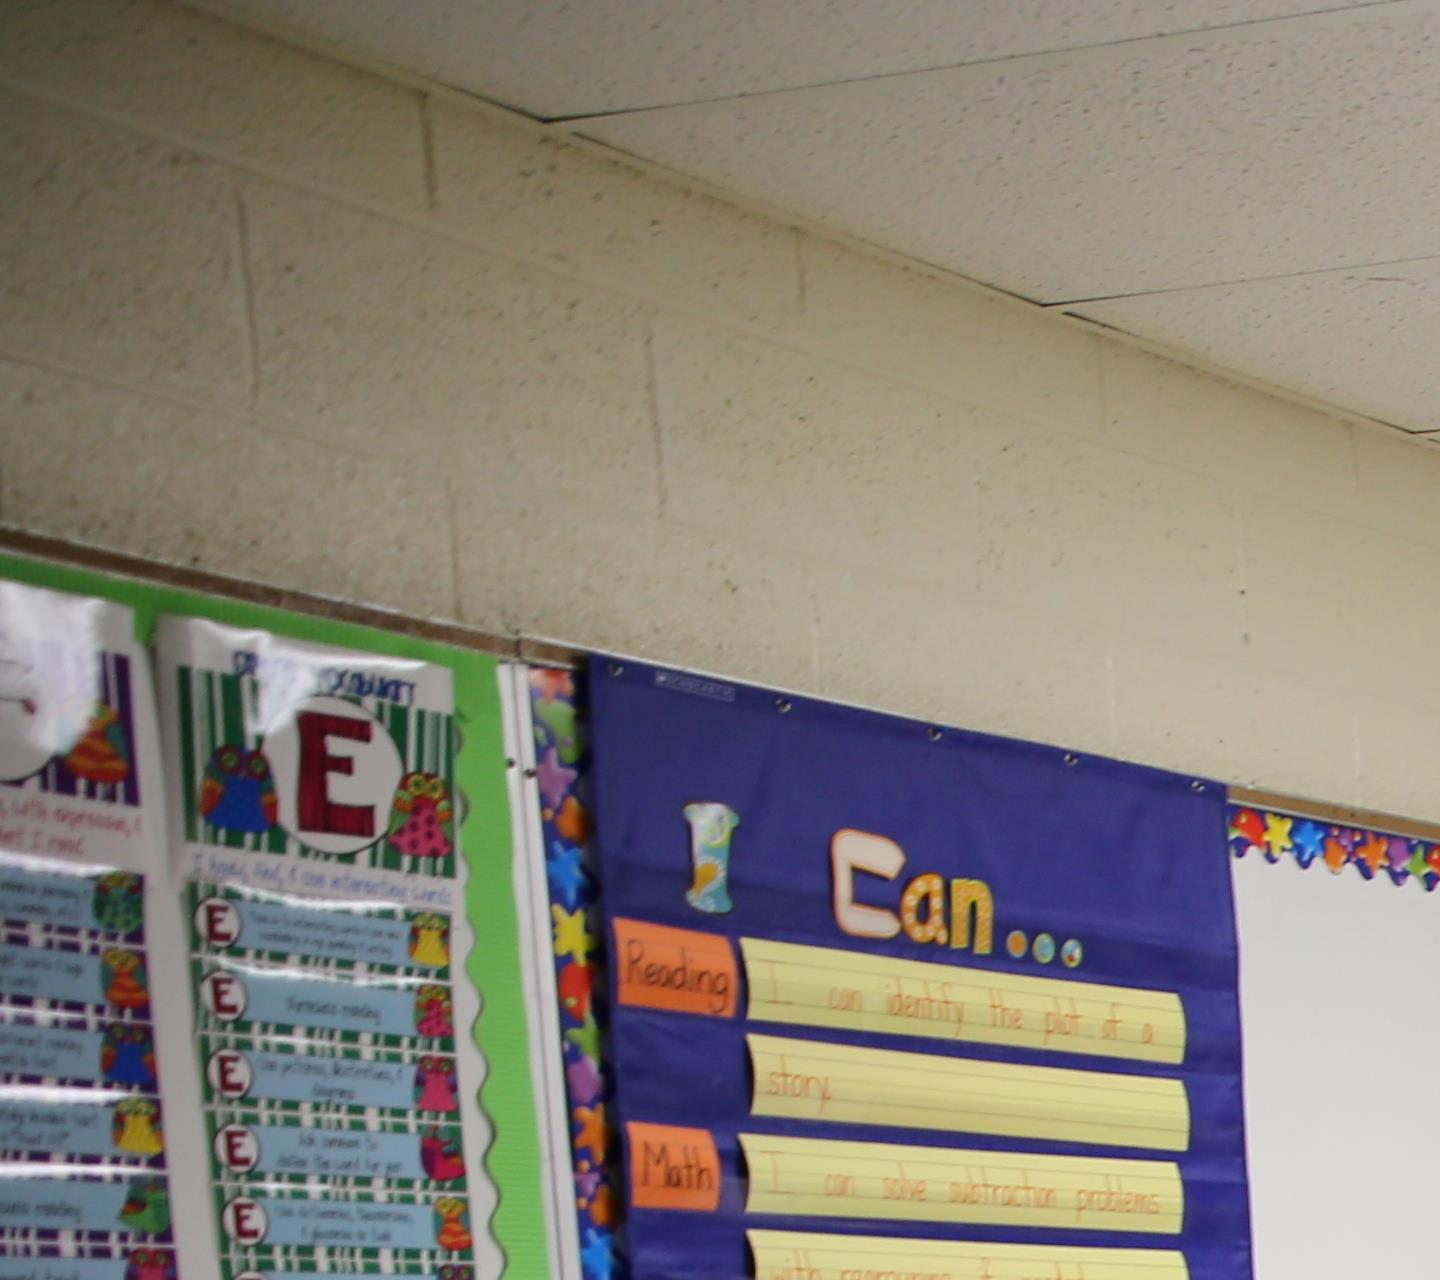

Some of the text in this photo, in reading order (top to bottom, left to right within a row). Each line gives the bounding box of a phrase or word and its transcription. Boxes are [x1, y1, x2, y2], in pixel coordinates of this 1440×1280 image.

[296, 710, 375, 838] E
[683, 801, 740, 914] I
[207, 904, 231, 942] E
[211, 976, 238, 1015] E
[626, 939, 729, 1013] Reading
[758, 959, 1153, 1045] I can identify the plot of a
[218, 1055, 244, 1093] E
[224, 1130, 251, 1167] E
[643, 1141, 713, 1191] Math
[763, 1151, 1160, 1224] I can solve subtraction problems
[232, 1202, 259, 1238] E
